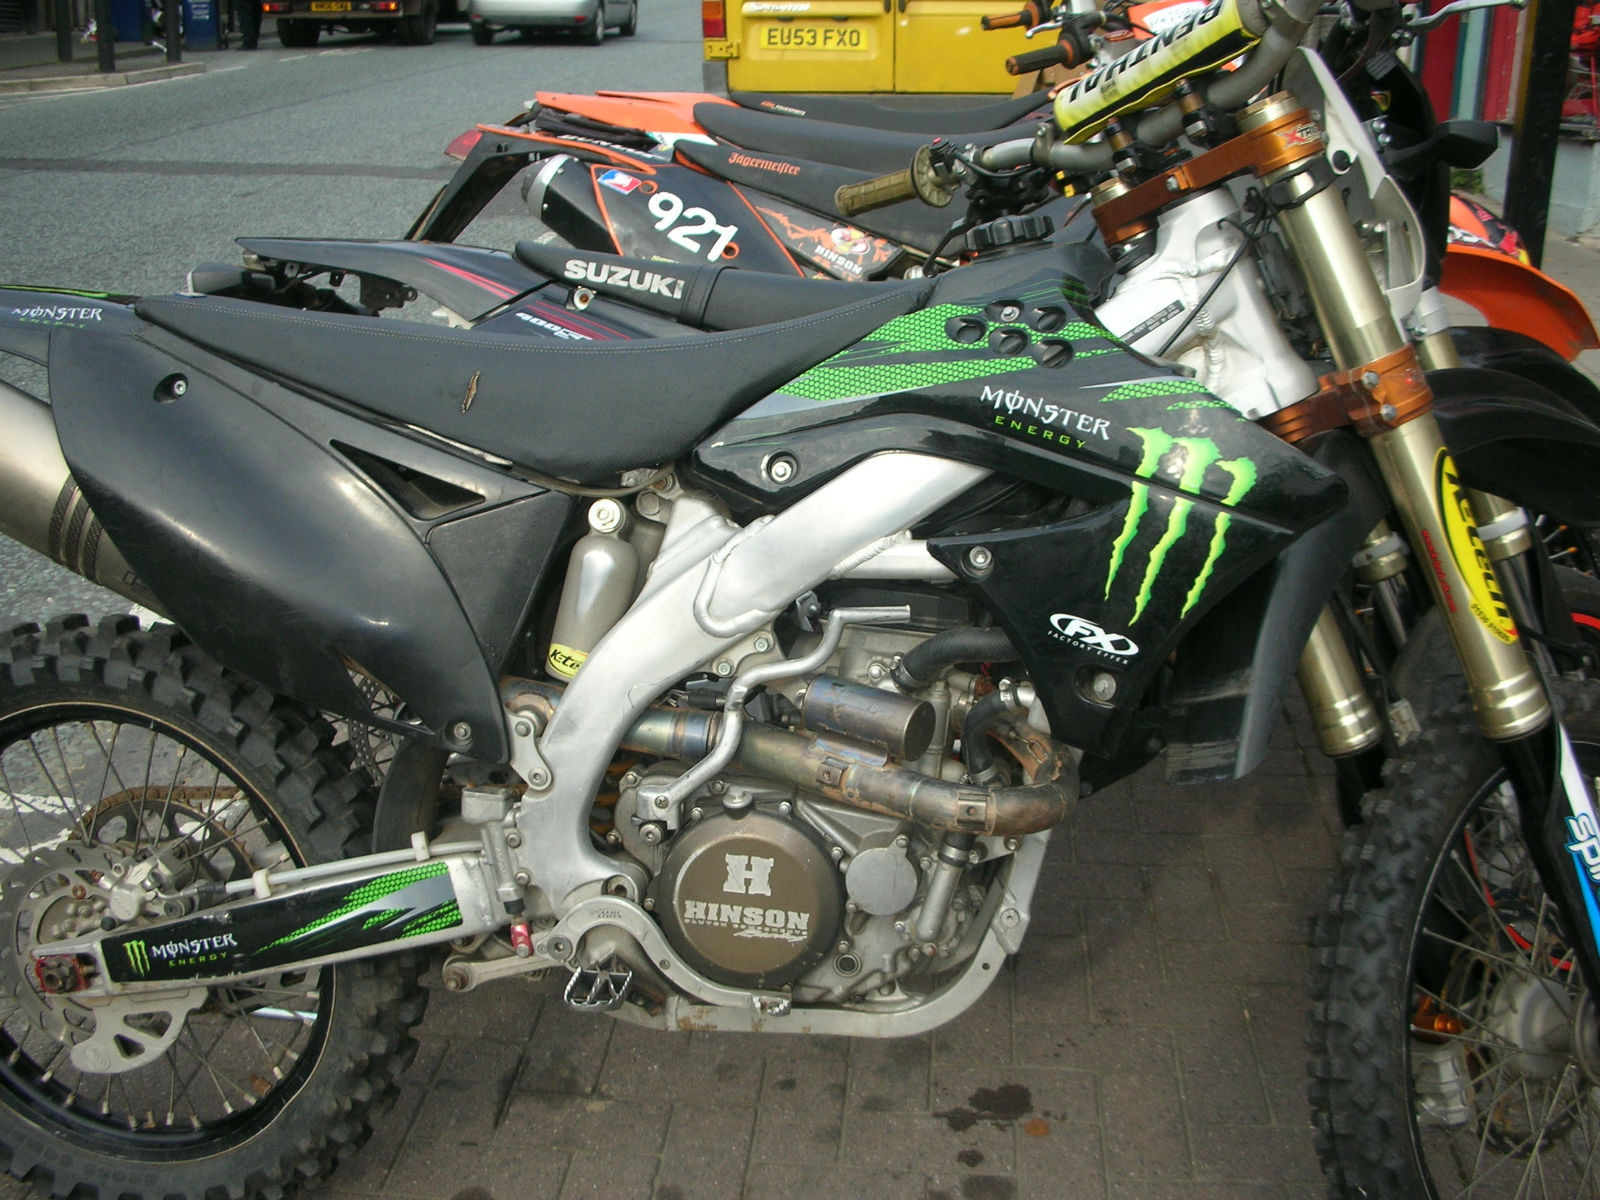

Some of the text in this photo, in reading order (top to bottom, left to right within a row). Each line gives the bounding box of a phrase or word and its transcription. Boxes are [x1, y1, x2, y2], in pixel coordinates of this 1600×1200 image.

[767, 28, 817, 46] EU53
[648, 191, 739, 262] 921
[814, 244, 864, 275] HINSON
[563, 259, 686, 300] SUZUKI
[11, 305, 103, 321] MONSTER
[979, 385, 1111, 441] MONSTER
[994, 415, 1087, 450] ENERGY
[550, 649, 581, 670] K-te
[1047, 629, 1129, 666] FACTORY EFFEX
[723, 853, 774, 897] H
[684, 900, 809, 930] HINSON
[151, 933, 238, 959] MONSTER
[169, 951, 228, 967] ENERGY
